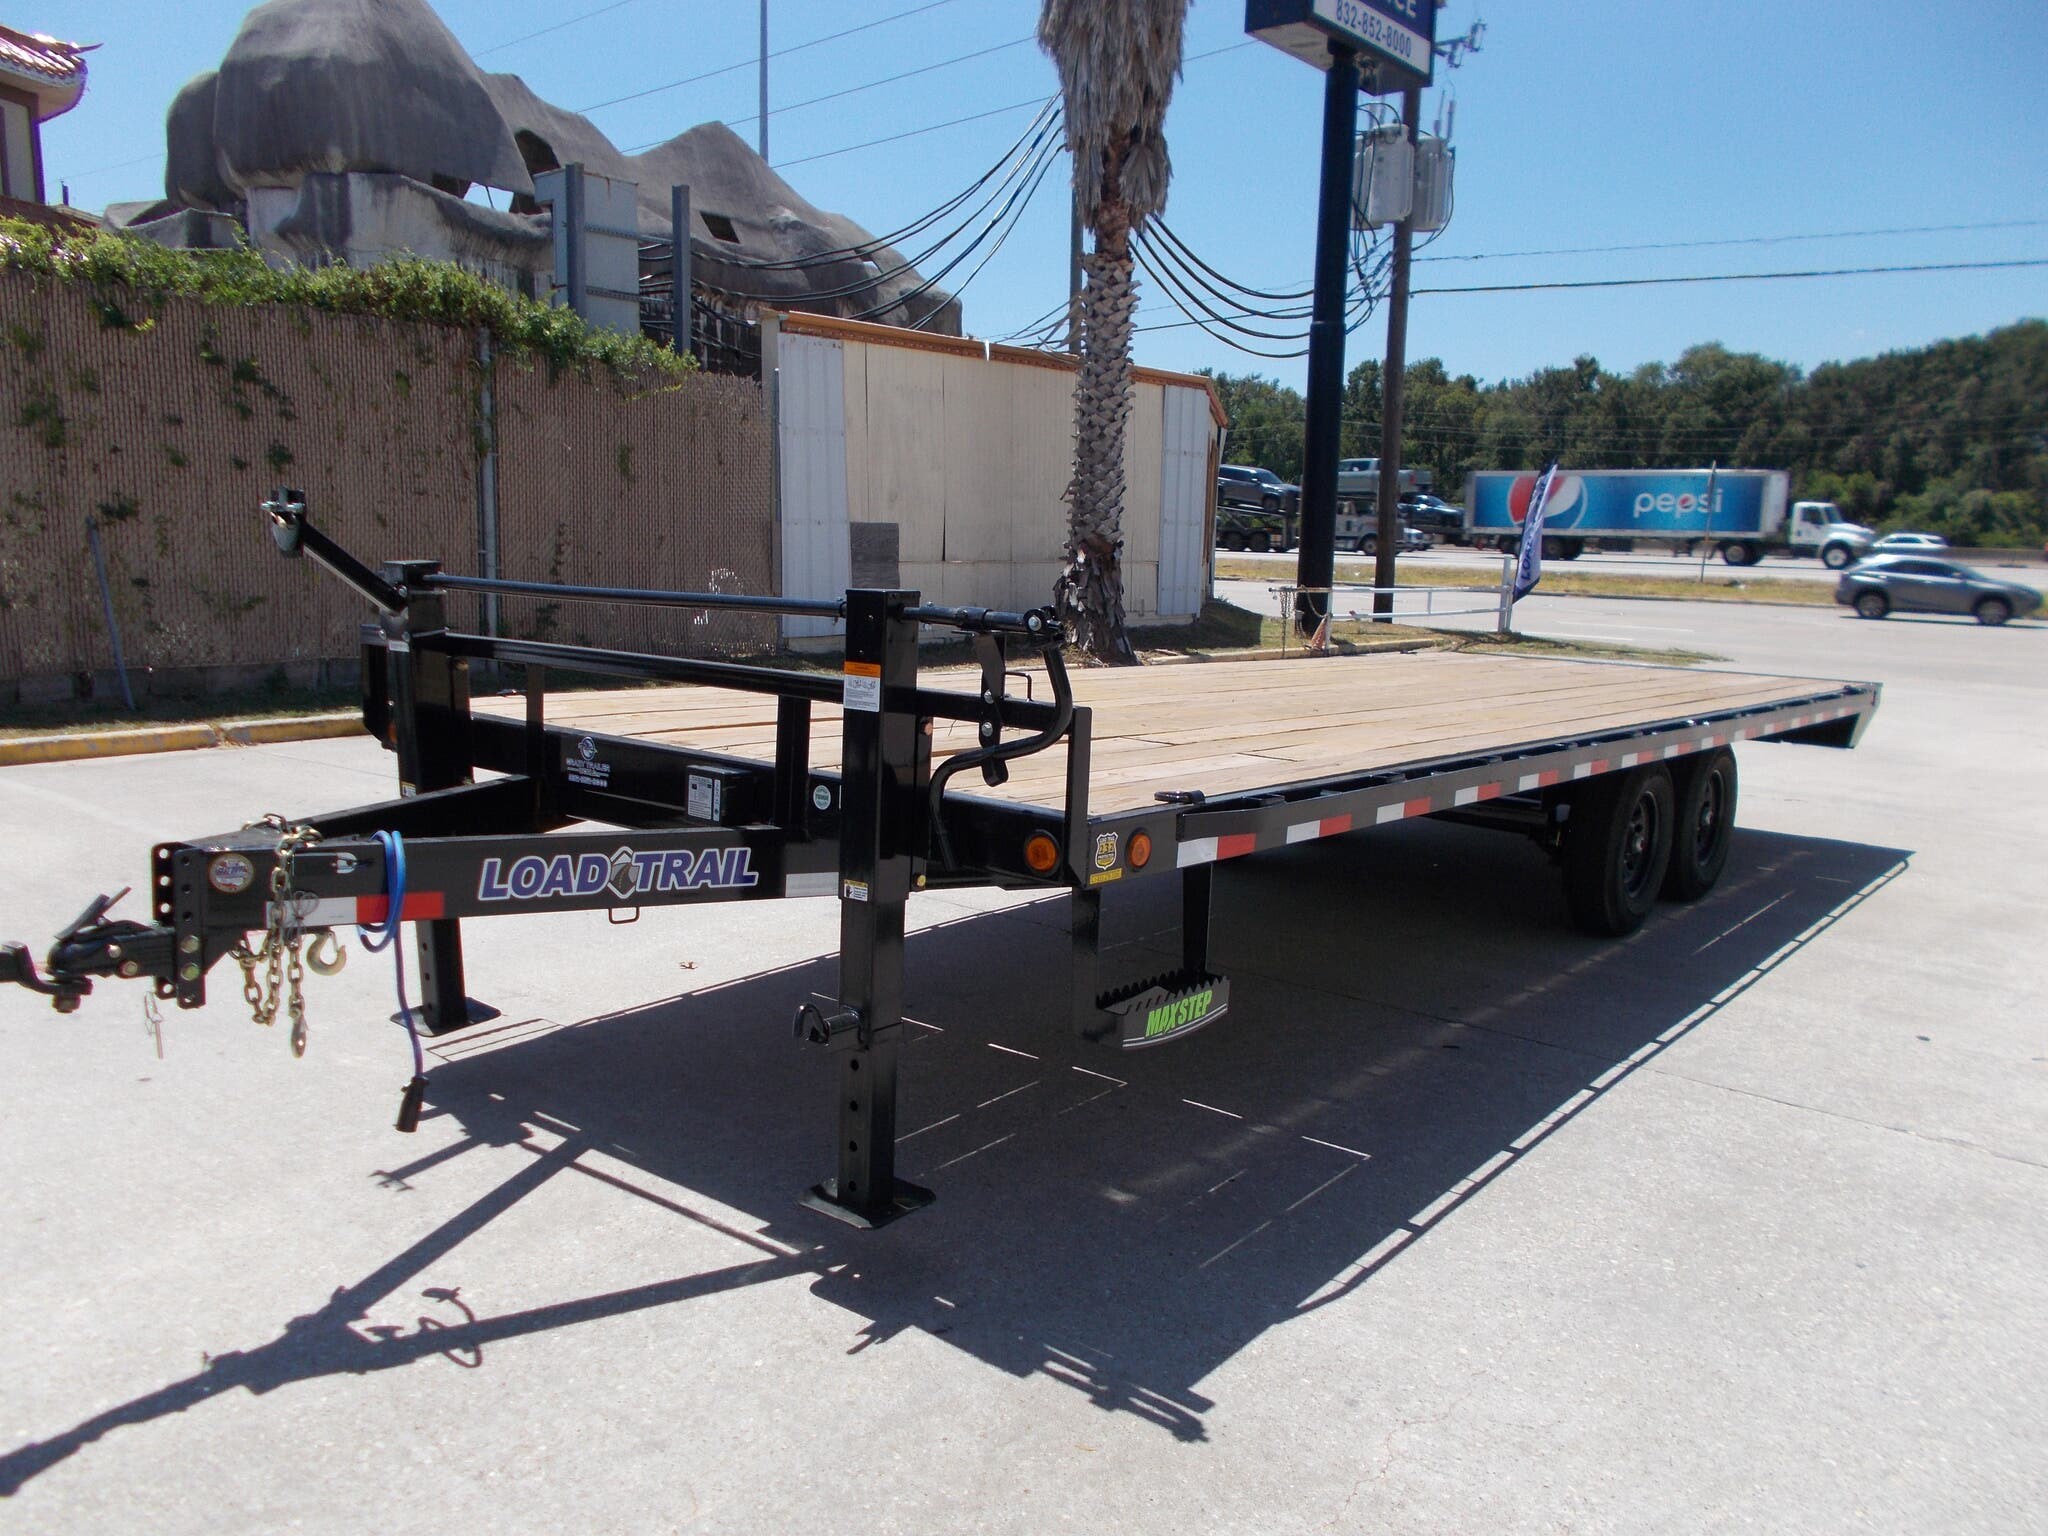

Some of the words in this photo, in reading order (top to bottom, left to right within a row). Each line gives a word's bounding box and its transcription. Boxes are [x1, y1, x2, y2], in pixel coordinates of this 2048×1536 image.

[1336, 0, 1412, 58] 832-852-8000
[1633, 488, 1723, 518] pepsi
[478, 854, 612, 901] LOAD
[631, 847, 759, 892] TRAIL
